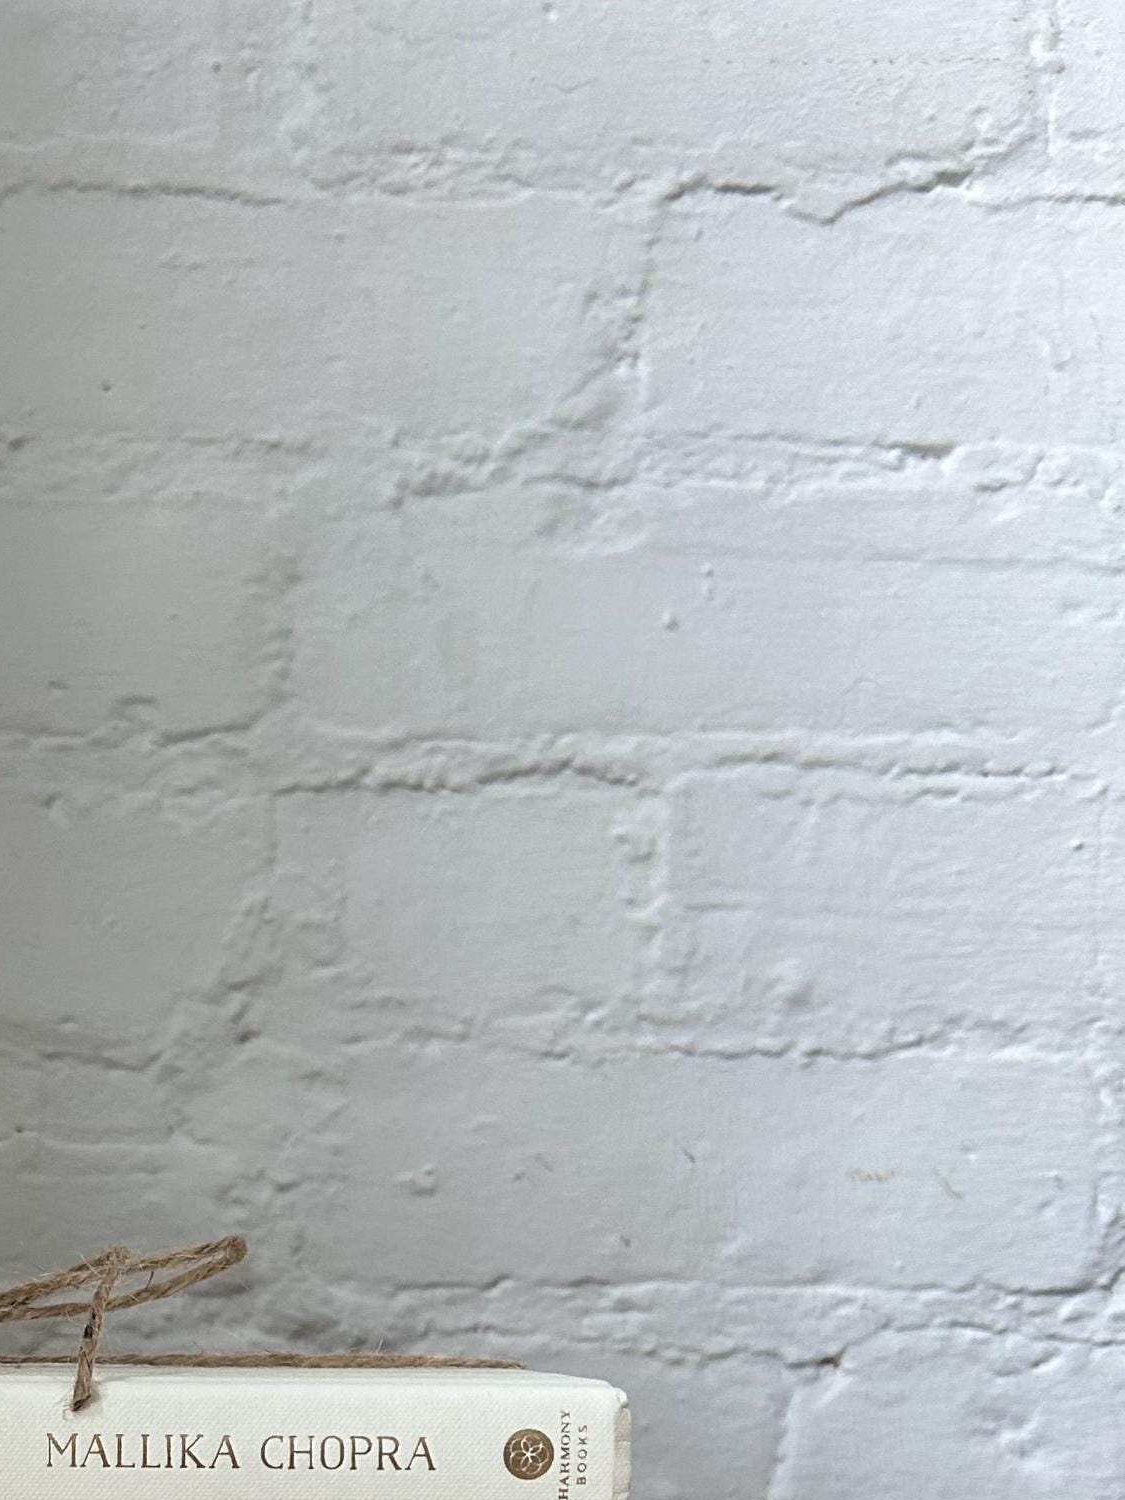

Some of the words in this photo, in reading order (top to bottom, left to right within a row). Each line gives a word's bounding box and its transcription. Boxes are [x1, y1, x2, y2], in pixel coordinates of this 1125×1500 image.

[46, 1432, 240, 1470] MALLIKA
[260, 1434, 436, 1472] CHOPRA
[558, 1410, 571, 1500] HARMONY
[576, 1424, 588, 1485] BOOKS
